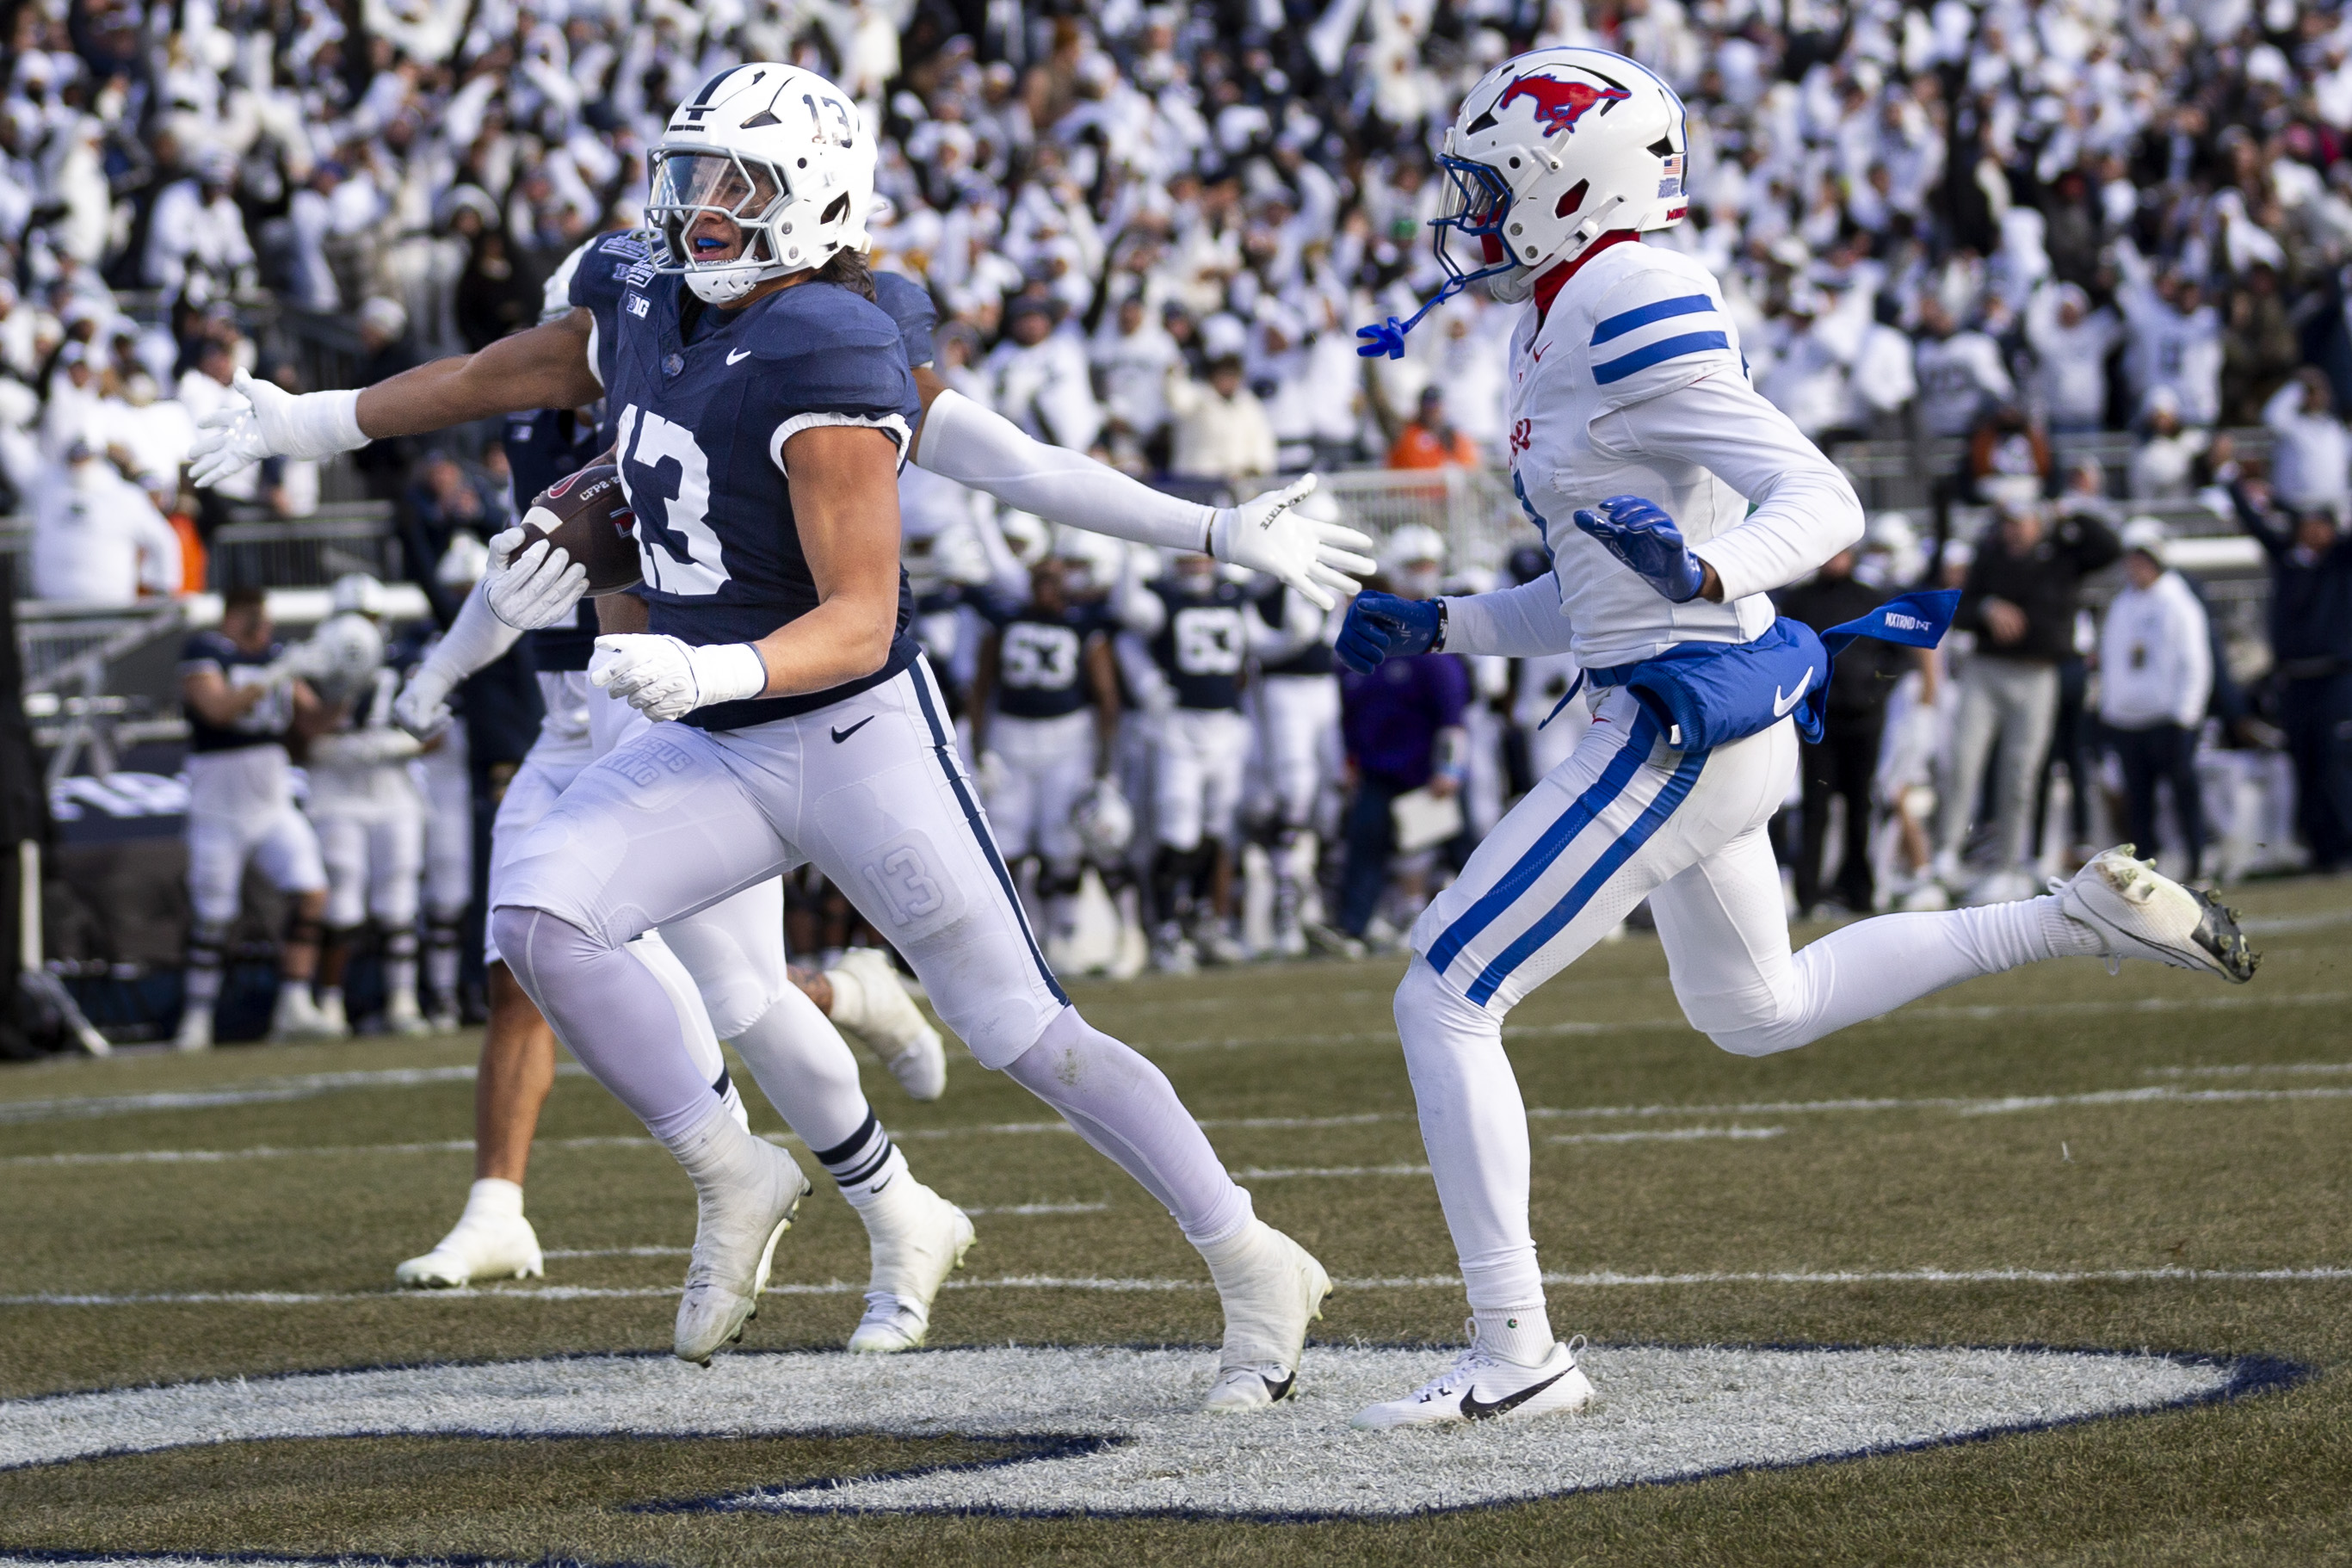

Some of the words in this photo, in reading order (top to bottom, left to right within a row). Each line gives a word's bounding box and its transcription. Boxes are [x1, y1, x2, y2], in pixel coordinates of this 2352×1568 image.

[802, 94, 853, 148] 13
[616, 403, 732, 596] 13
[1000, 621, 1080, 690] 53
[861, 846, 944, 928] 13
